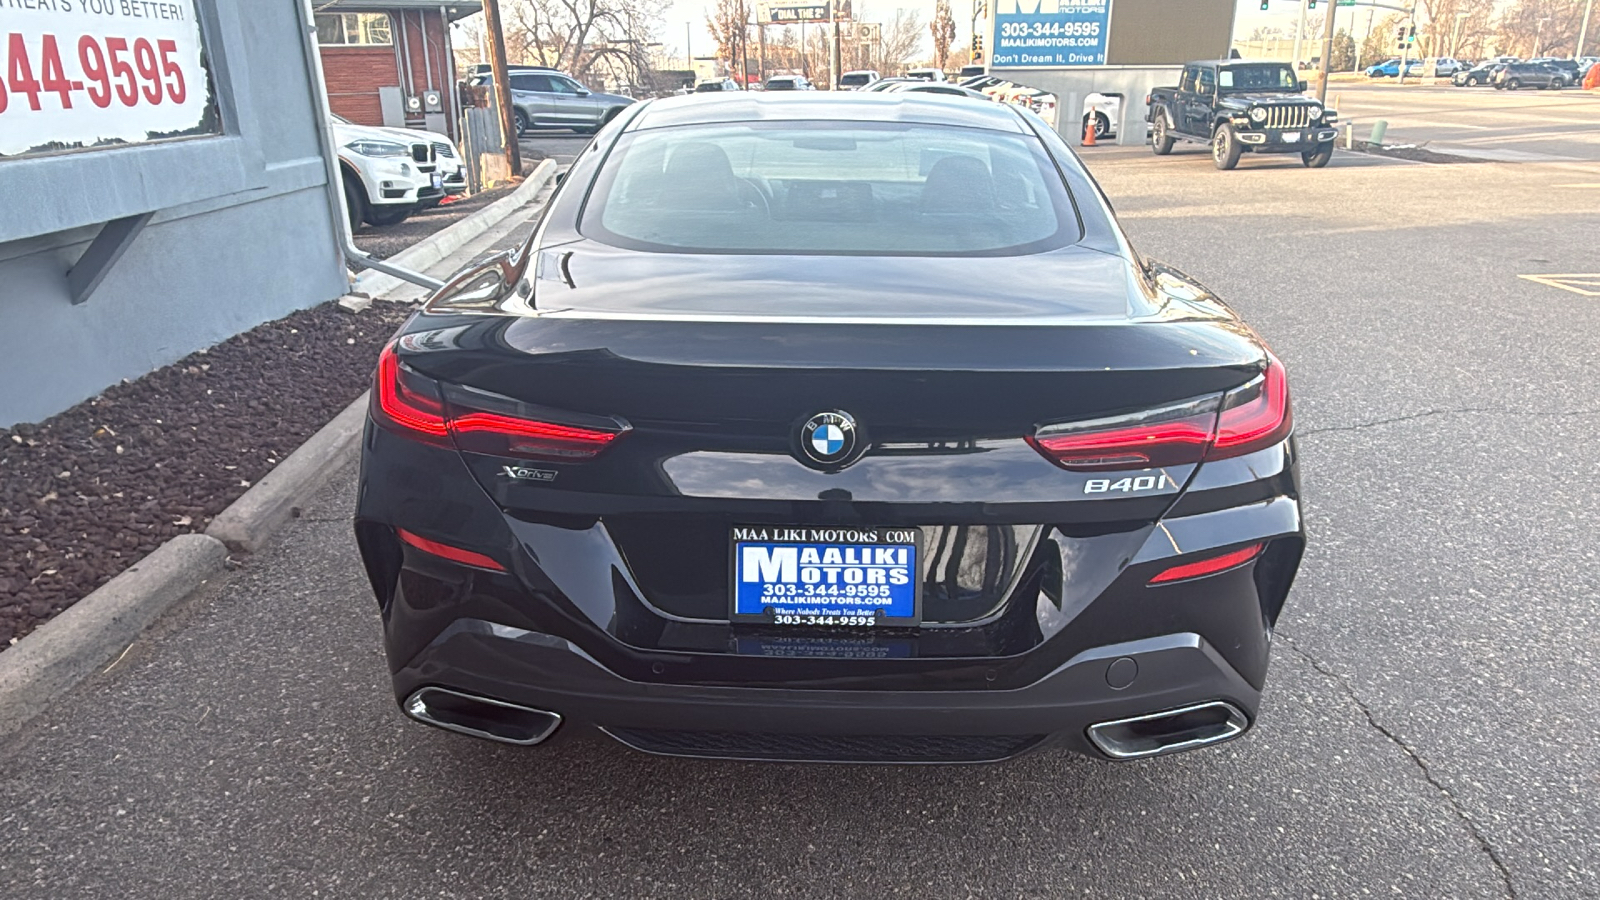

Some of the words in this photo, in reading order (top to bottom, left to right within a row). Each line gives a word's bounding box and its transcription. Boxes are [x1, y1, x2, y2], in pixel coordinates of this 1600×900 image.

[80, 0, 114, 15] YOU
[121, 0, 184, 20] BETTER!
[778, 9, 797, 19] DIAL
[798, 8, 814, 19] THE
[1001, 22, 1100, 37] 303-344-9595
[1001, 37, 1099, 47] MAALIKIMOTORS.COM
[993, 54, 1018, 63] Don't
[1021, 54, 1052, 63] Dream
[1056, 53, 1065, 63] It,
[1069, 53, 1093, 62] Drive
[1097, 53, 1104, 62] It
[0, 33, 186, 114] 44-9595
[810, 530, 878, 542] MOTORS
[763, 585, 890, 597] 303-344-9595
[761, 596, 892, 605] MAALIKIMOTORS.COM
[775, 607, 796, 616] Where
[822, 608, 841, 616] Treats
[843, 608, 855, 616] You
[774, 616, 876, 626] 303-344-9595
